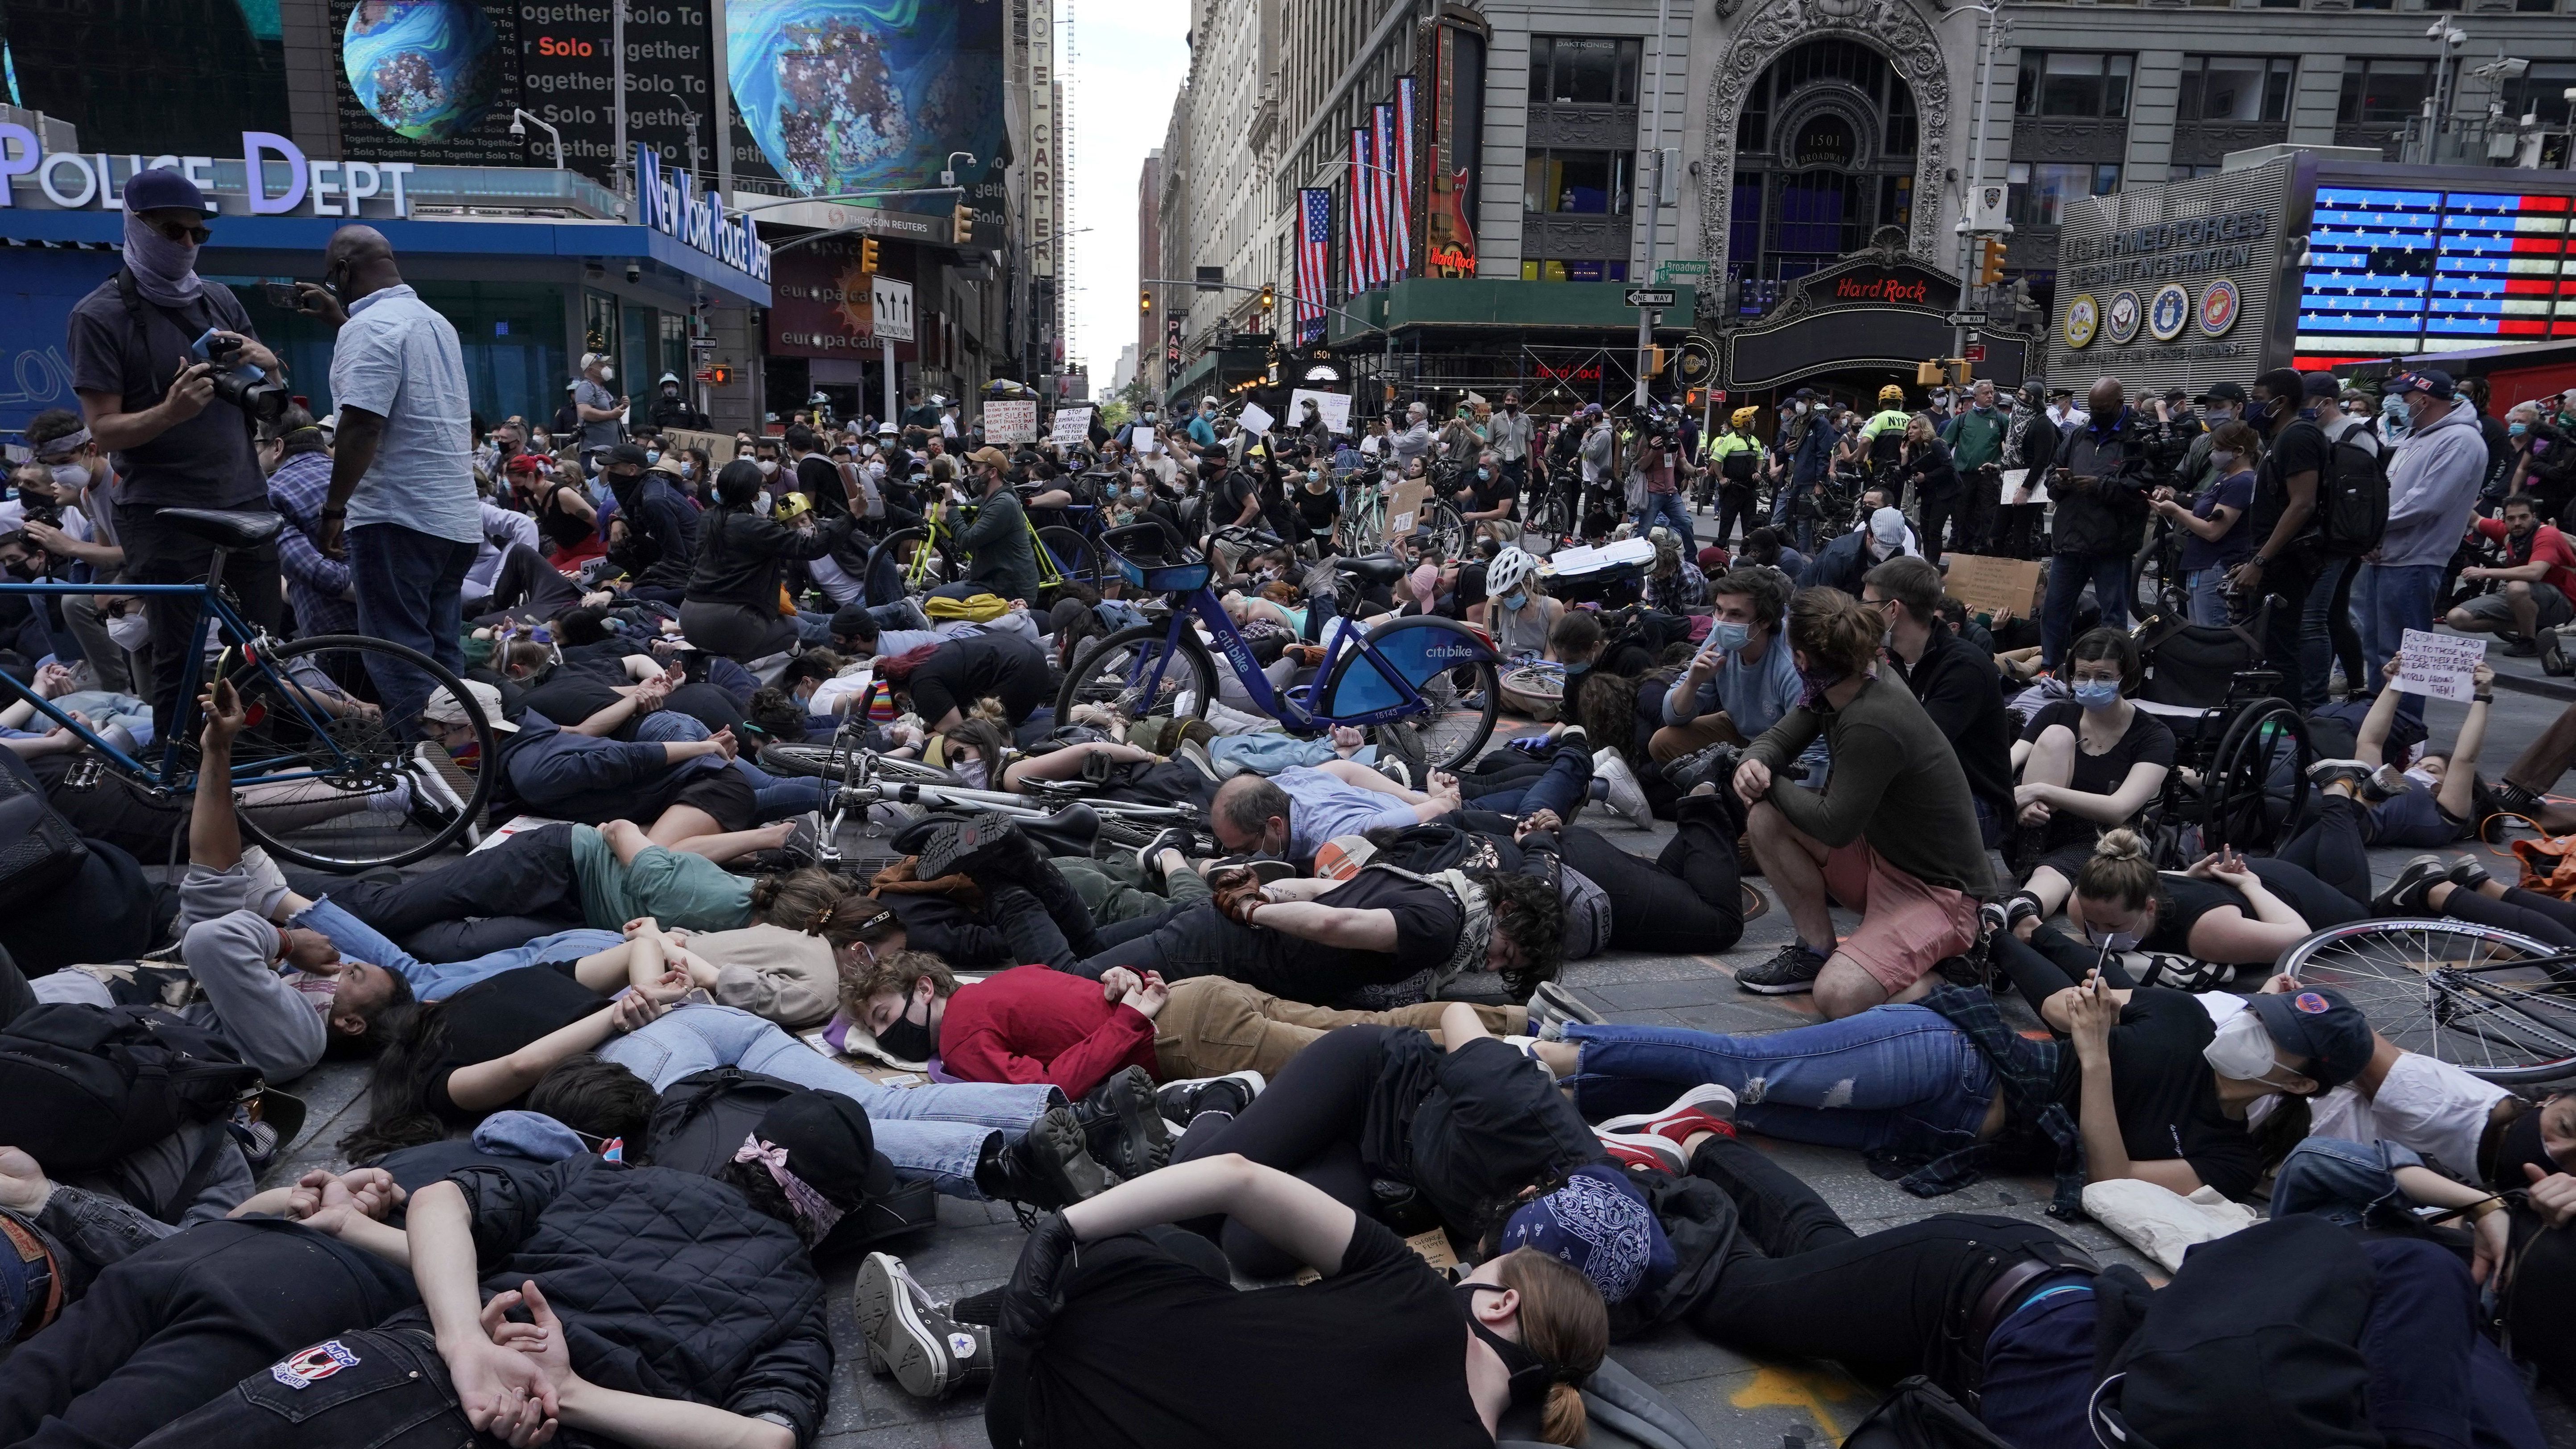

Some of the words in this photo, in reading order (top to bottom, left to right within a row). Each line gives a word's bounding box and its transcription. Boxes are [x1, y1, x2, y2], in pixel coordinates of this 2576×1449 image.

[522, 6, 610, 24] ogether
[539, 37, 592, 57] Solo
[599, 38, 700, 62] Tgether
[1032, 0, 1048, 110] HOTEL
[526, 72, 615, 93] ogether
[624, 73, 674, 92] Solo
[543, 104, 596, 124] Solo
[344, 135, 384, 144] Together
[387, 135, 408, 144] Solo
[454, 137, 474, 146] Solo
[1810, 135, 1840, 146] 1501
[354, 148, 375, 157] Solo
[377, 149, 417, 158] Together
[420, 150, 441, 158] Solo
[443, 151, 483, 161] Together
[486, 152, 507, 160] Solo
[1800, 152, 1847, 164] BROADWAY
[242, 131, 415, 217] DEPT
[1033, 124, 1050, 261] CARTER
[643, 141, 679, 236] NEW
[679, 168, 713, 255] YORK
[714, 191, 747, 271] POLICE
[748, 215, 771, 283] DEPT
[849, 215, 890, 228] THOMSON
[892, 220, 927, 232] REUTERS
[2096, 223, 2172, 257] ARMED
[2175, 208, 2267, 246] FORCES
[1431, 247, 1455, 266] Hard
[1454, 251, 1476, 273] Rock
[1668, 262, 1706, 274] Broadway
[1660, 270, 1665, 281] 43
[1837, 278, 1883, 297] Hard
[1884, 280, 1927, 303] Rock
[875, 323, 886, 332] ONLY
[889, 324, 899, 334] ONLY
[901, 327, 911, 336] ONLY
[1314, 350, 1330, 359] 1501
[1692, 357, 1707, 367] Rock
[1888, 416, 1910, 427] NYP
[669, 432, 715, 458] BLACK
[2405, 629, 2434, 643] RACISM
[2456, 638, 2480, 649] DEAD
[2435, 647, 2457, 655] THOSE
[2402, 652, 2428, 663] CLOSED
[2453, 658, 2474, 667] EYES
[2401, 673, 2425, 682] WORLD
[2428, 675, 2454, 683] AROUND
[2431, 685, 2455, 697] THEM!
[1375, 709, 1398, 720] 18143
[2387, 923, 2463, 935] WEINMANN
[1414, 1234, 1443, 1246] GEORGE
[1422, 1240, 1444, 1250] FLOYD
[323, 1344, 354, 1366] AJBC
